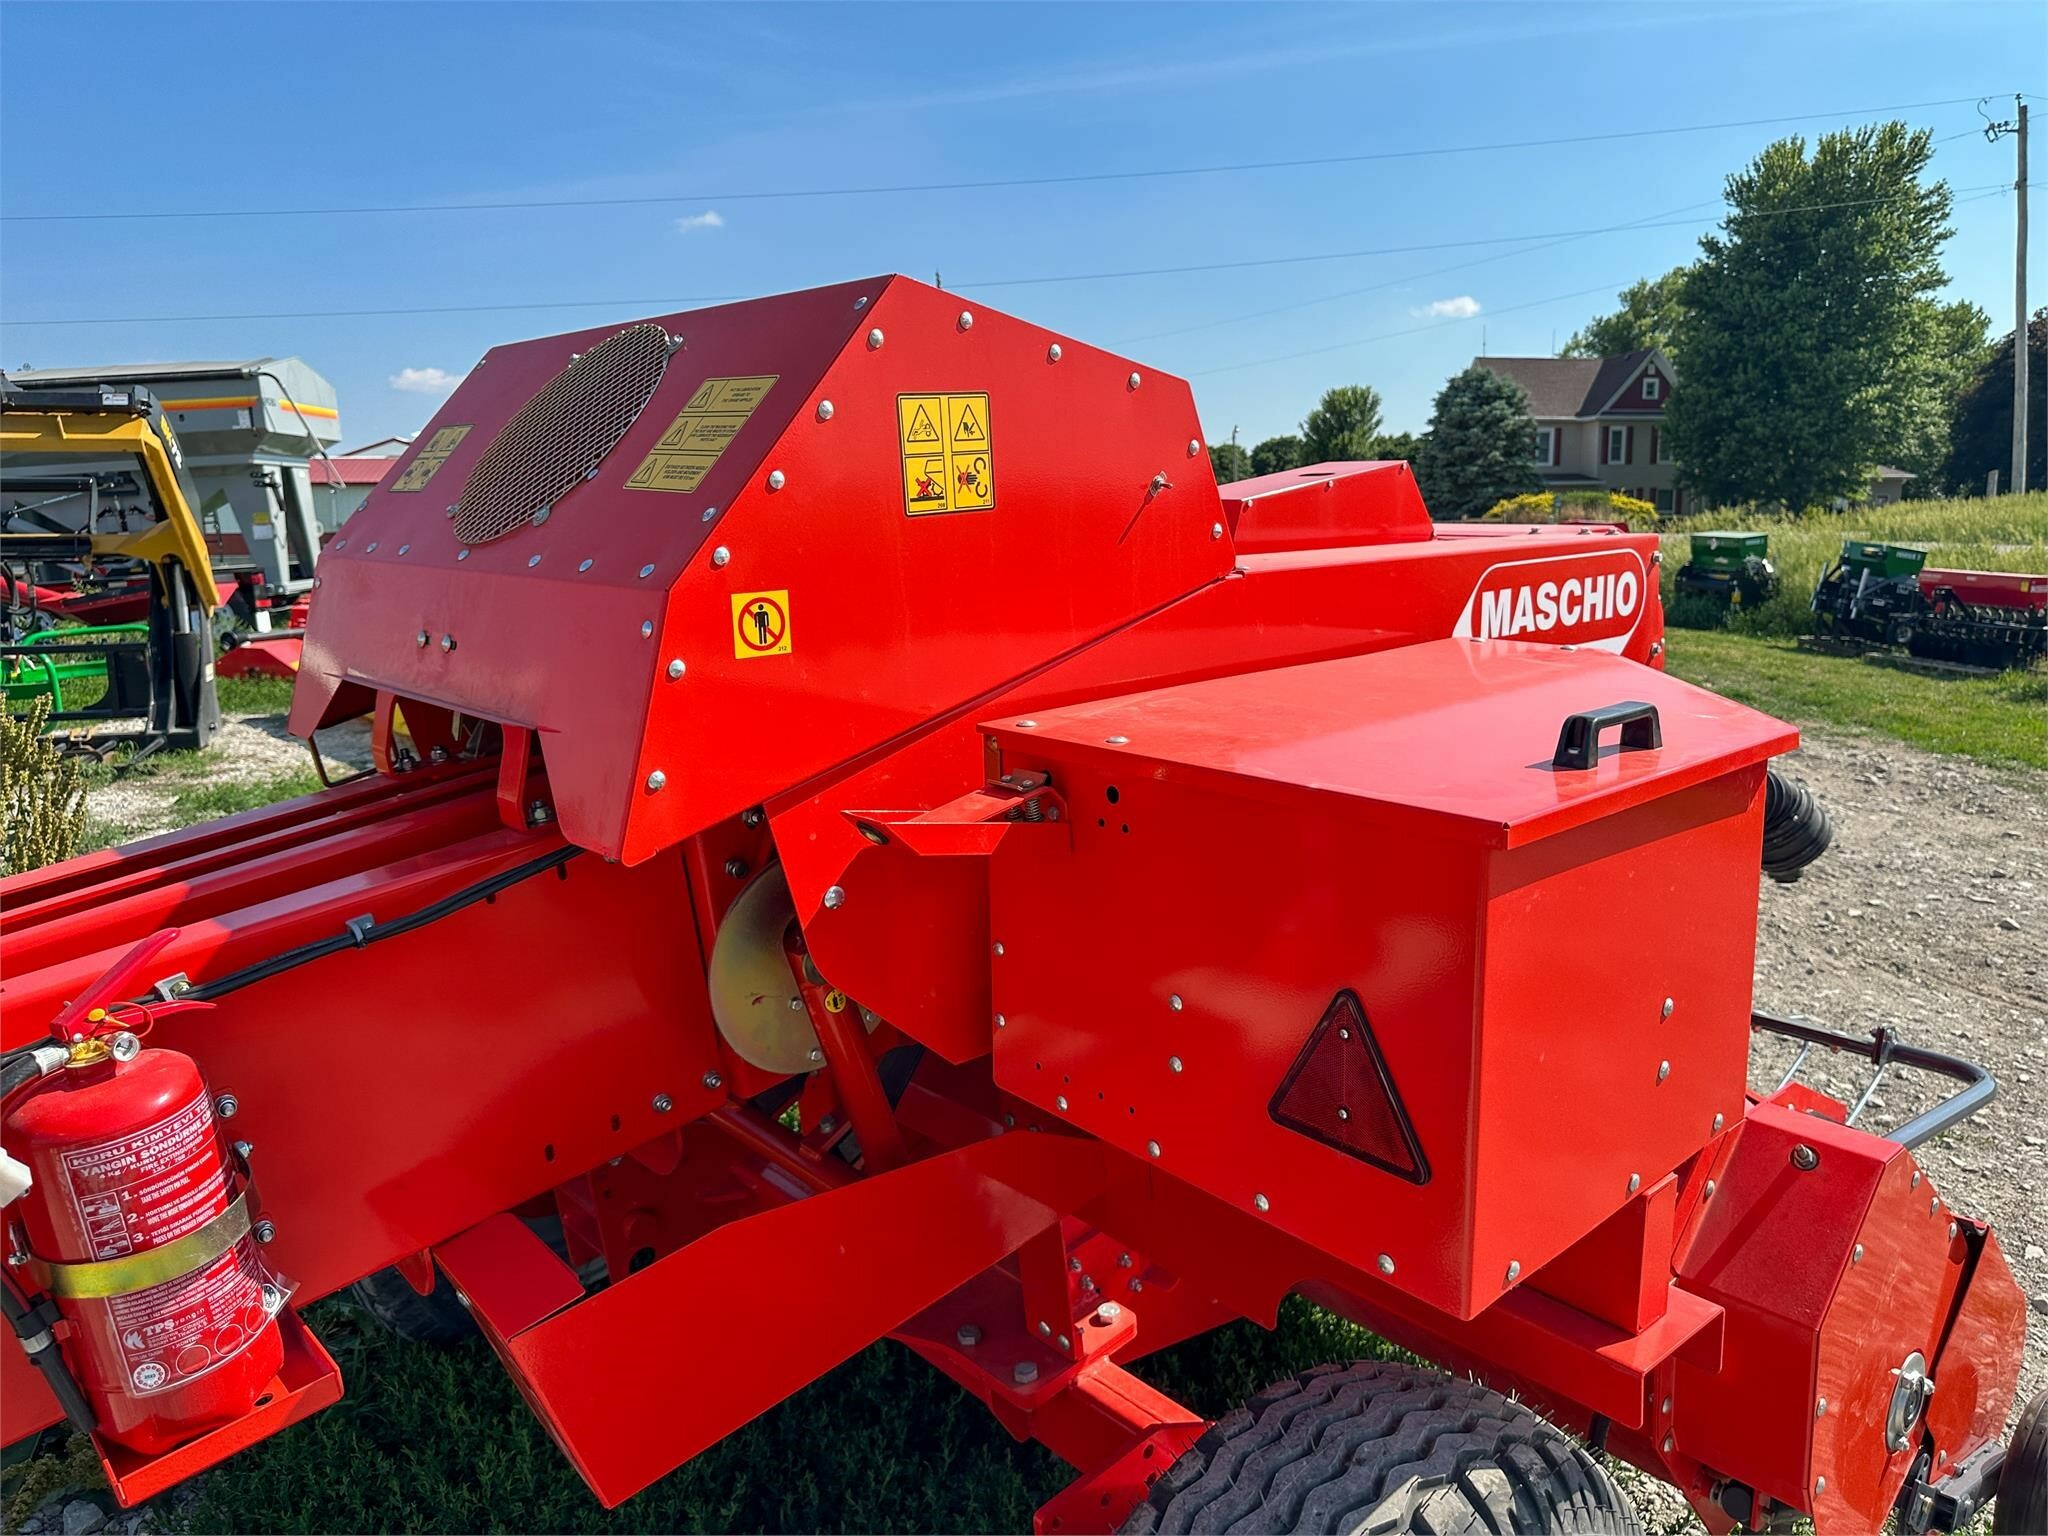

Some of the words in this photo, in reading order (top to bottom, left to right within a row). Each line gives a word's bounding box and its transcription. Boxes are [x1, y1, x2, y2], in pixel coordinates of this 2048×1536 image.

[1480, 570, 1638, 639] MASCHIO
[71, 1145, 126, 1166] KURU
[131, 1112, 194, 1148] KİMYEVİ
[80, 1154, 137, 1177] YANGIN
[140, 1120, 203, 1160] SÖNDÜRME
[130, 1156, 156, 1170] KURU
[140, 1162, 160, 1174] FIRE
